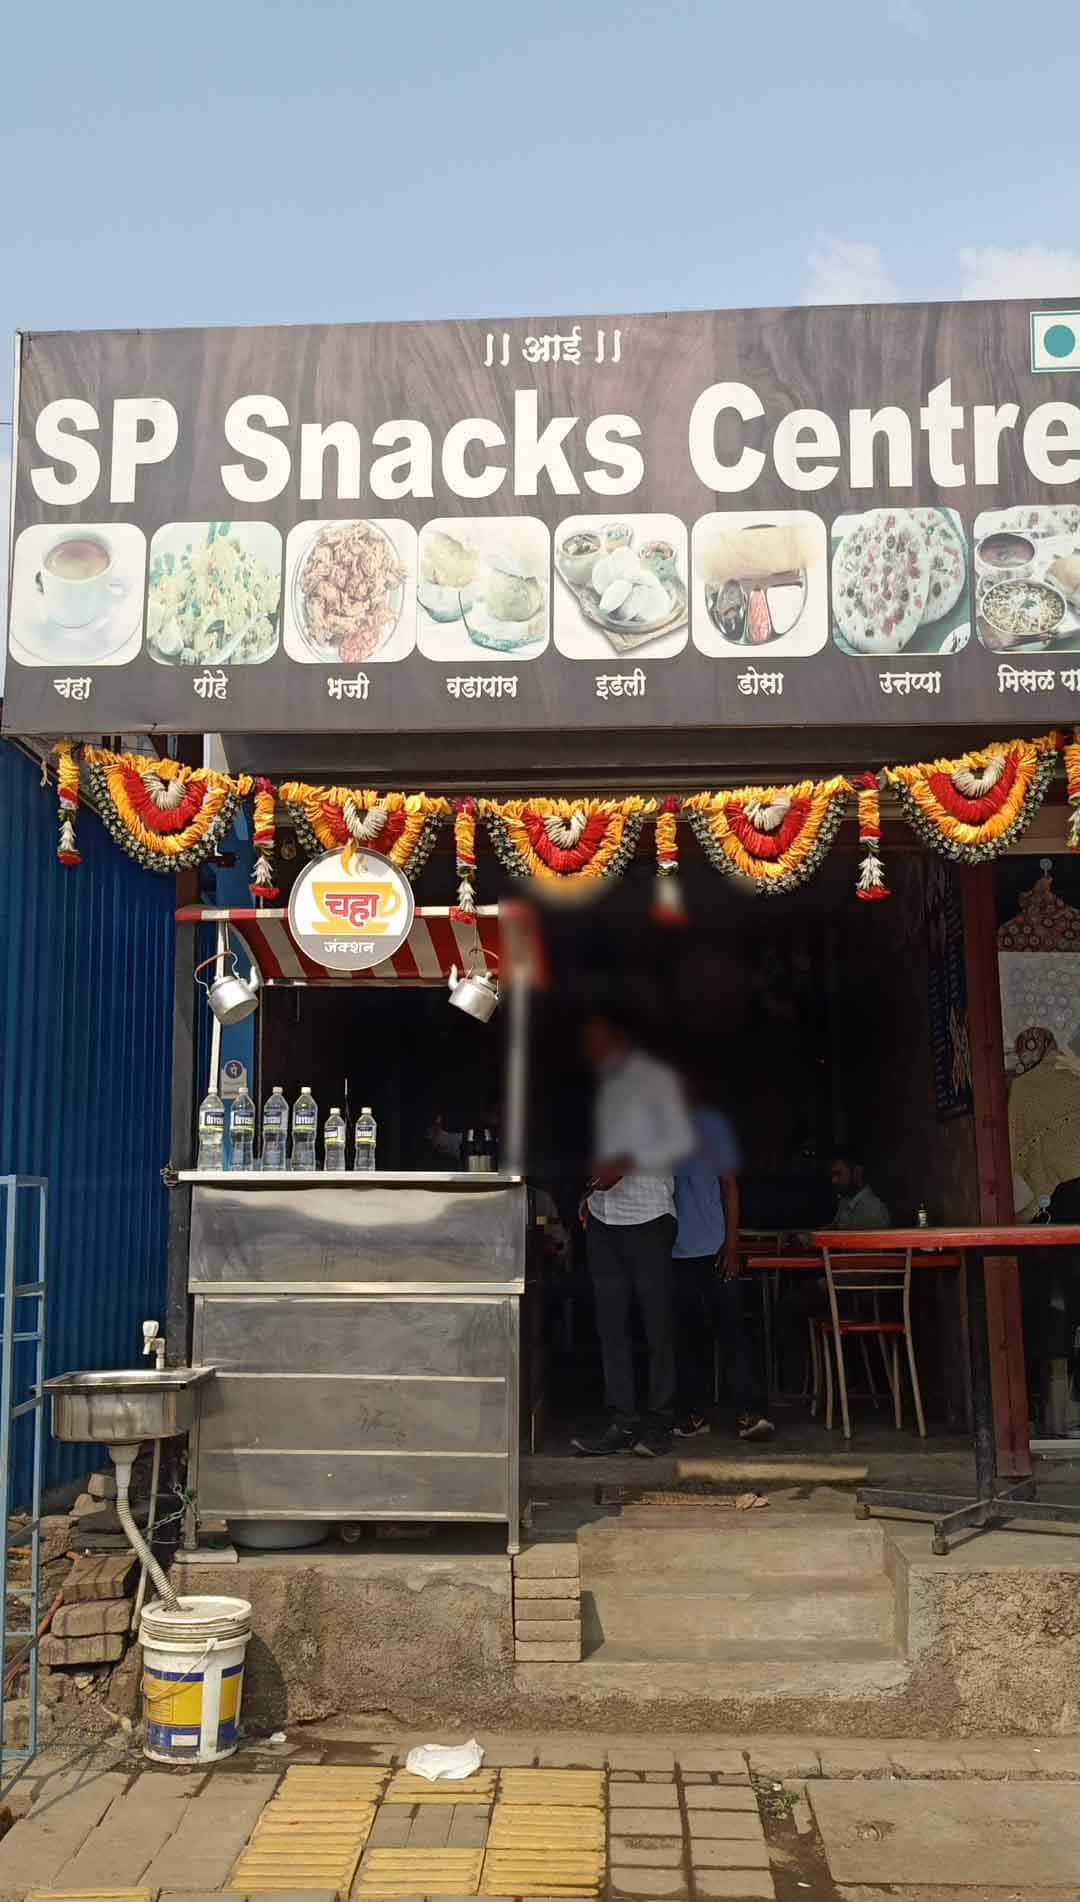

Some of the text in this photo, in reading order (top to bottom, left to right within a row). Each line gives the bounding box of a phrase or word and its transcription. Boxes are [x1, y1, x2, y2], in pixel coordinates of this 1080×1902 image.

[522, 326, 582, 365] आई
[30, 377, 1080, 505] SP Snacks Centre
[54, 677, 92, 700] चहा
[193, 670, 228, 699] पोहे
[327, 673, 370, 699] भजी
[446, 675, 518, 698] वडापाव
[595, 668, 646, 698] इडली
[737, 666, 784, 695] डोसा
[879, 671, 941, 695] उत्तप्पा
[997, 664, 1055, 693] मिसळ
[325, 894, 380, 927] चहा
[323, 939, 375, 953] जंक्शन
